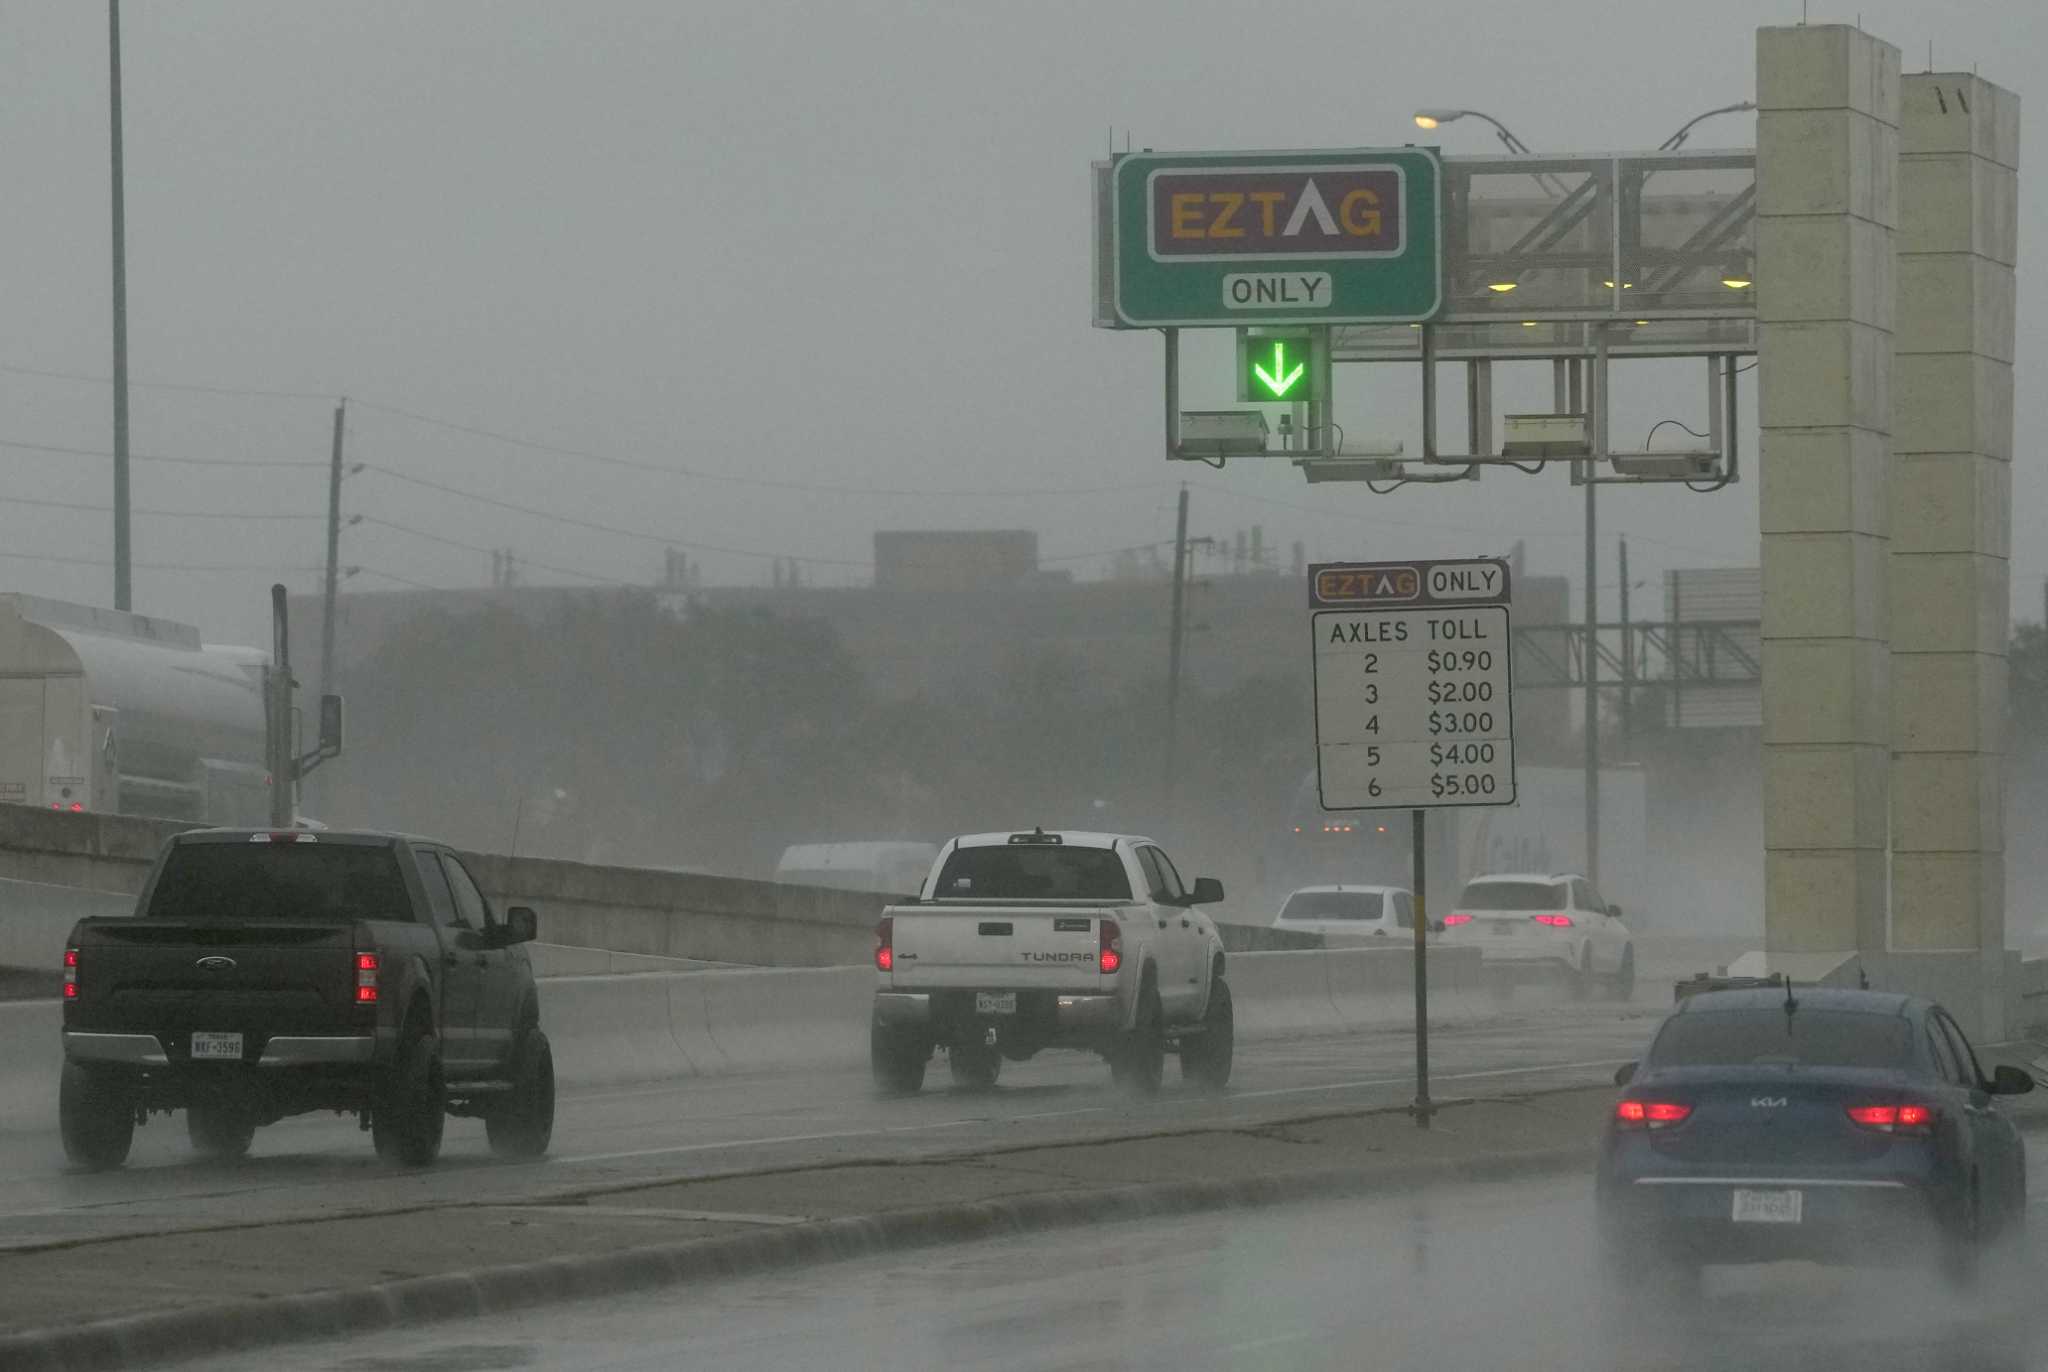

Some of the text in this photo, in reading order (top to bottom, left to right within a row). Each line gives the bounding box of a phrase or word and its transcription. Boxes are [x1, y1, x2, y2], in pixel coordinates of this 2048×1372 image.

[1231, 277, 1323, 304] ONLY
[1432, 570, 1497, 592] ONLY
[1330, 619, 1488, 643] AXLES TOLL
[1364, 650, 1492, 674] 2 $0.90
[1364, 680, 1493, 705] 3 $2.00
[1365, 710, 1494, 736] 4 $3.00
[1367, 742, 1495, 767] 5 $4.00
[1367, 772, 1496, 798] 6 $5.00
[1020, 952, 1095, 962] TUNDRA
